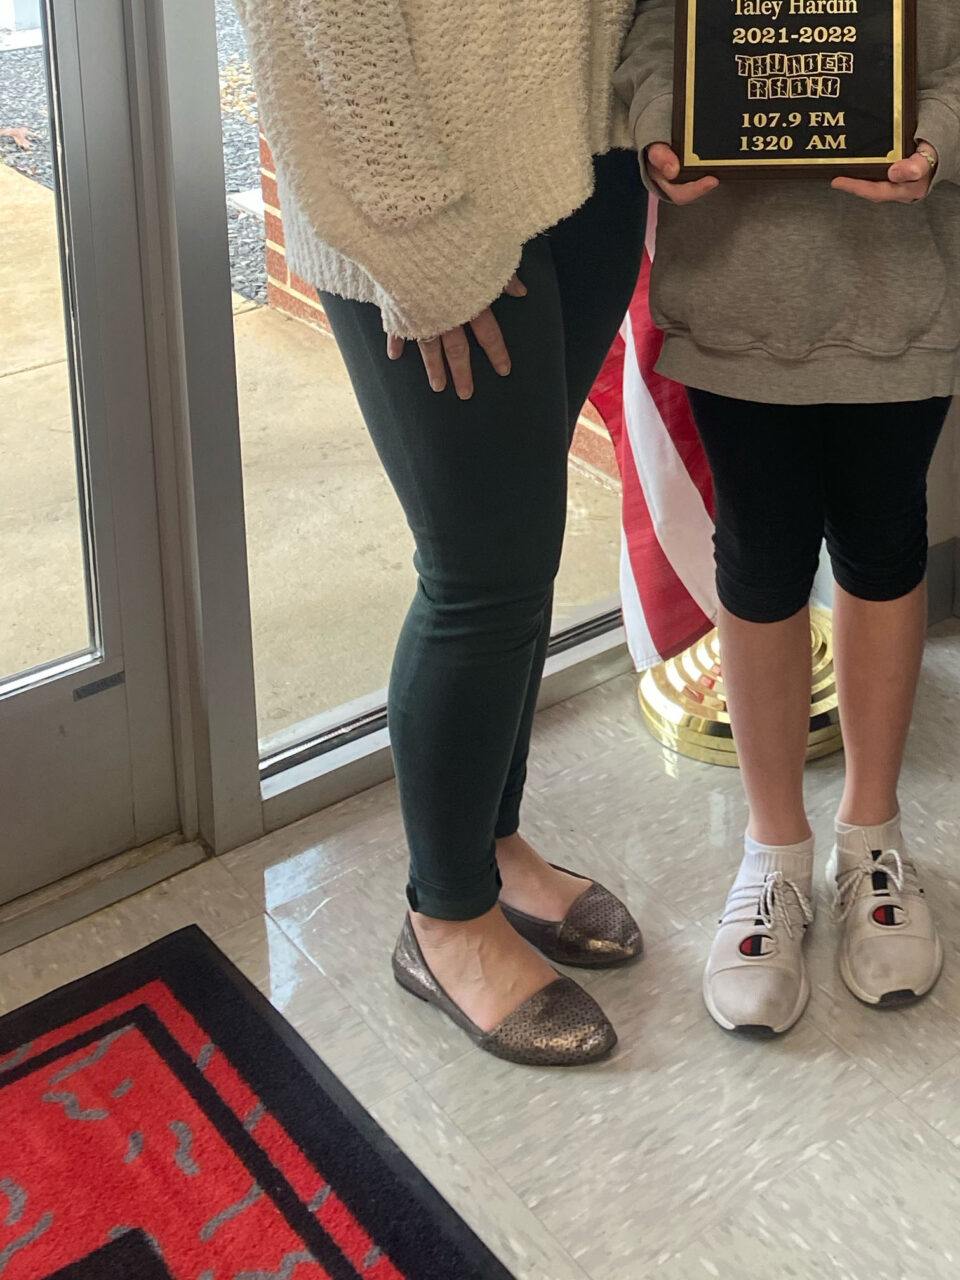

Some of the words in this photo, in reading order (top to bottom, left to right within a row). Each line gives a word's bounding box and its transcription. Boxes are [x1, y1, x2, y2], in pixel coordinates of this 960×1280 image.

[732, 27, 857, 44] 2021-2022
[735, 52, 854, 76] THUNDER
[741, 112, 802, 128] 107.9
[808, 111, 845, 127] FM
[739, 135, 793, 151] 1320
[805, 135, 847, 150] AM
